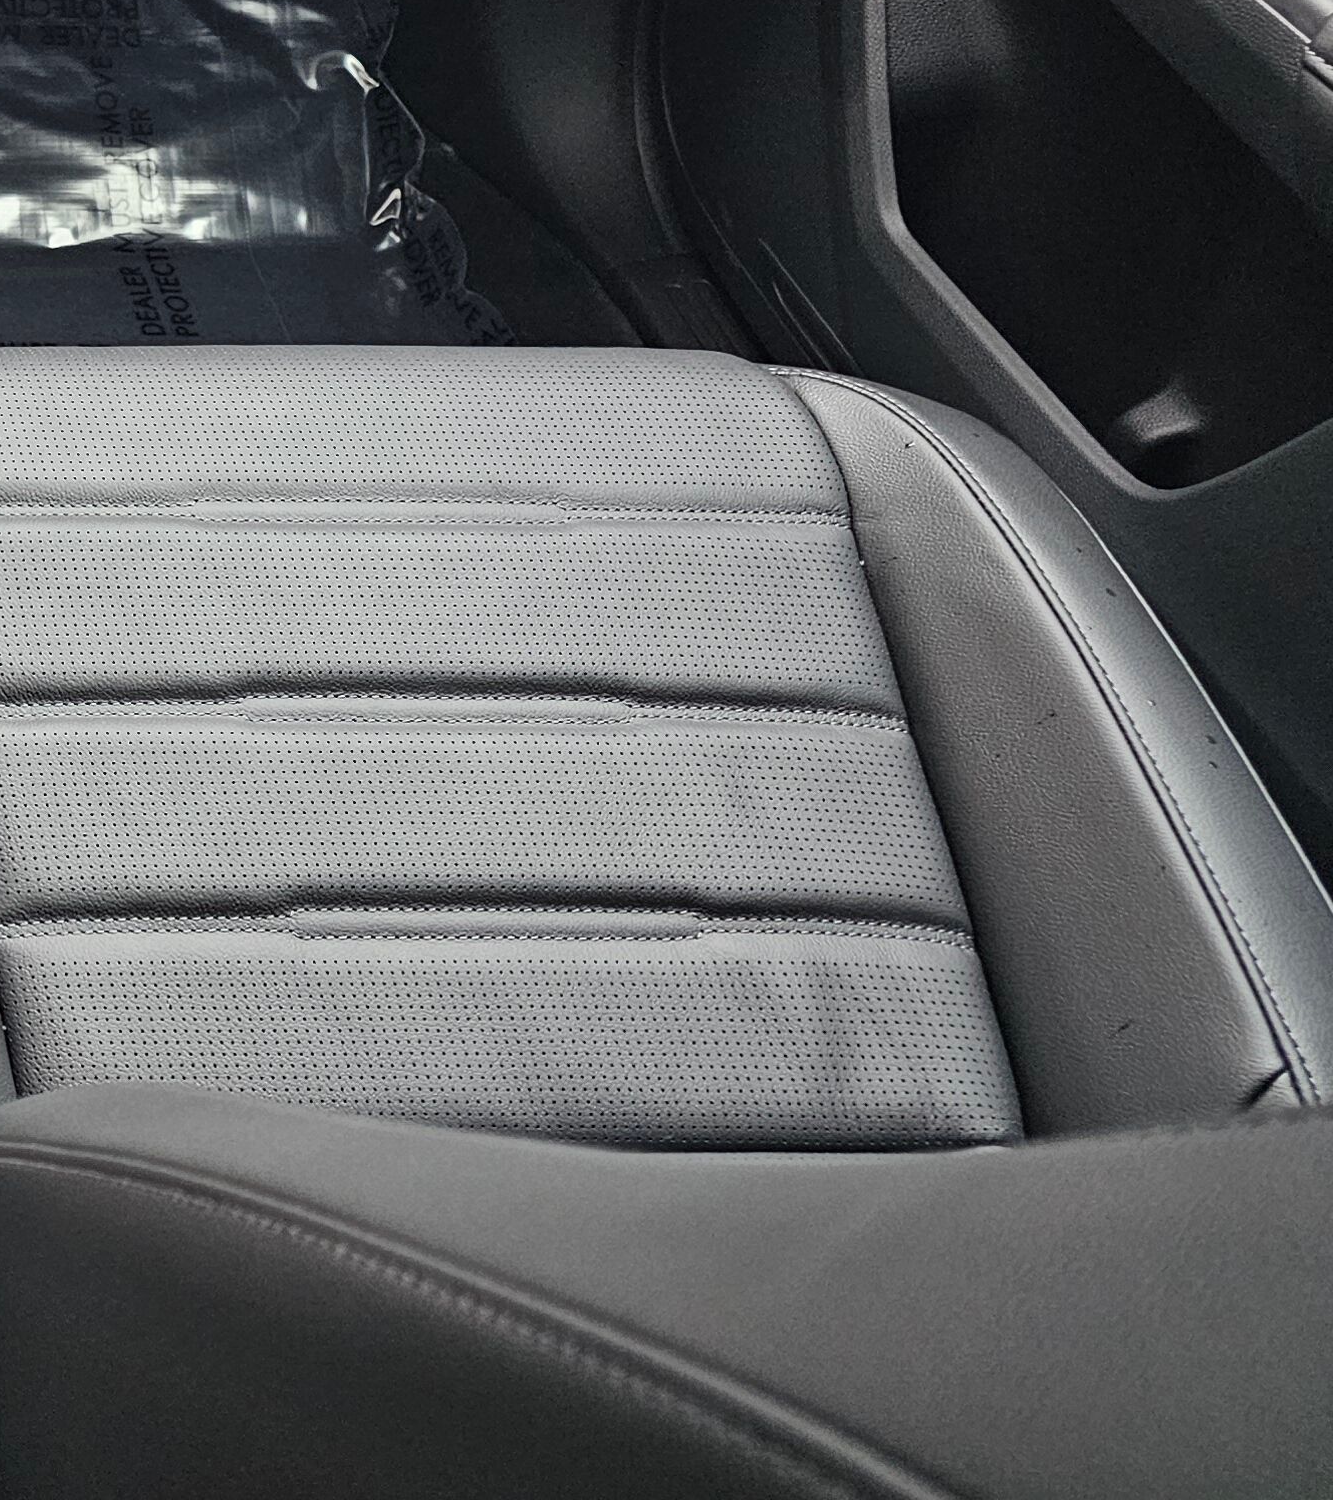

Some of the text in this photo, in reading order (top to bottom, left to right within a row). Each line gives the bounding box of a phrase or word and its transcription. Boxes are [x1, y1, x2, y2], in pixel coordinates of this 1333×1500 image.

[36, 22, 141, 50] DEALER
[90, 56, 168, 338] DEALER MUST REMOVE
[128, 107, 199, 339] PROTECTIVE COVER
